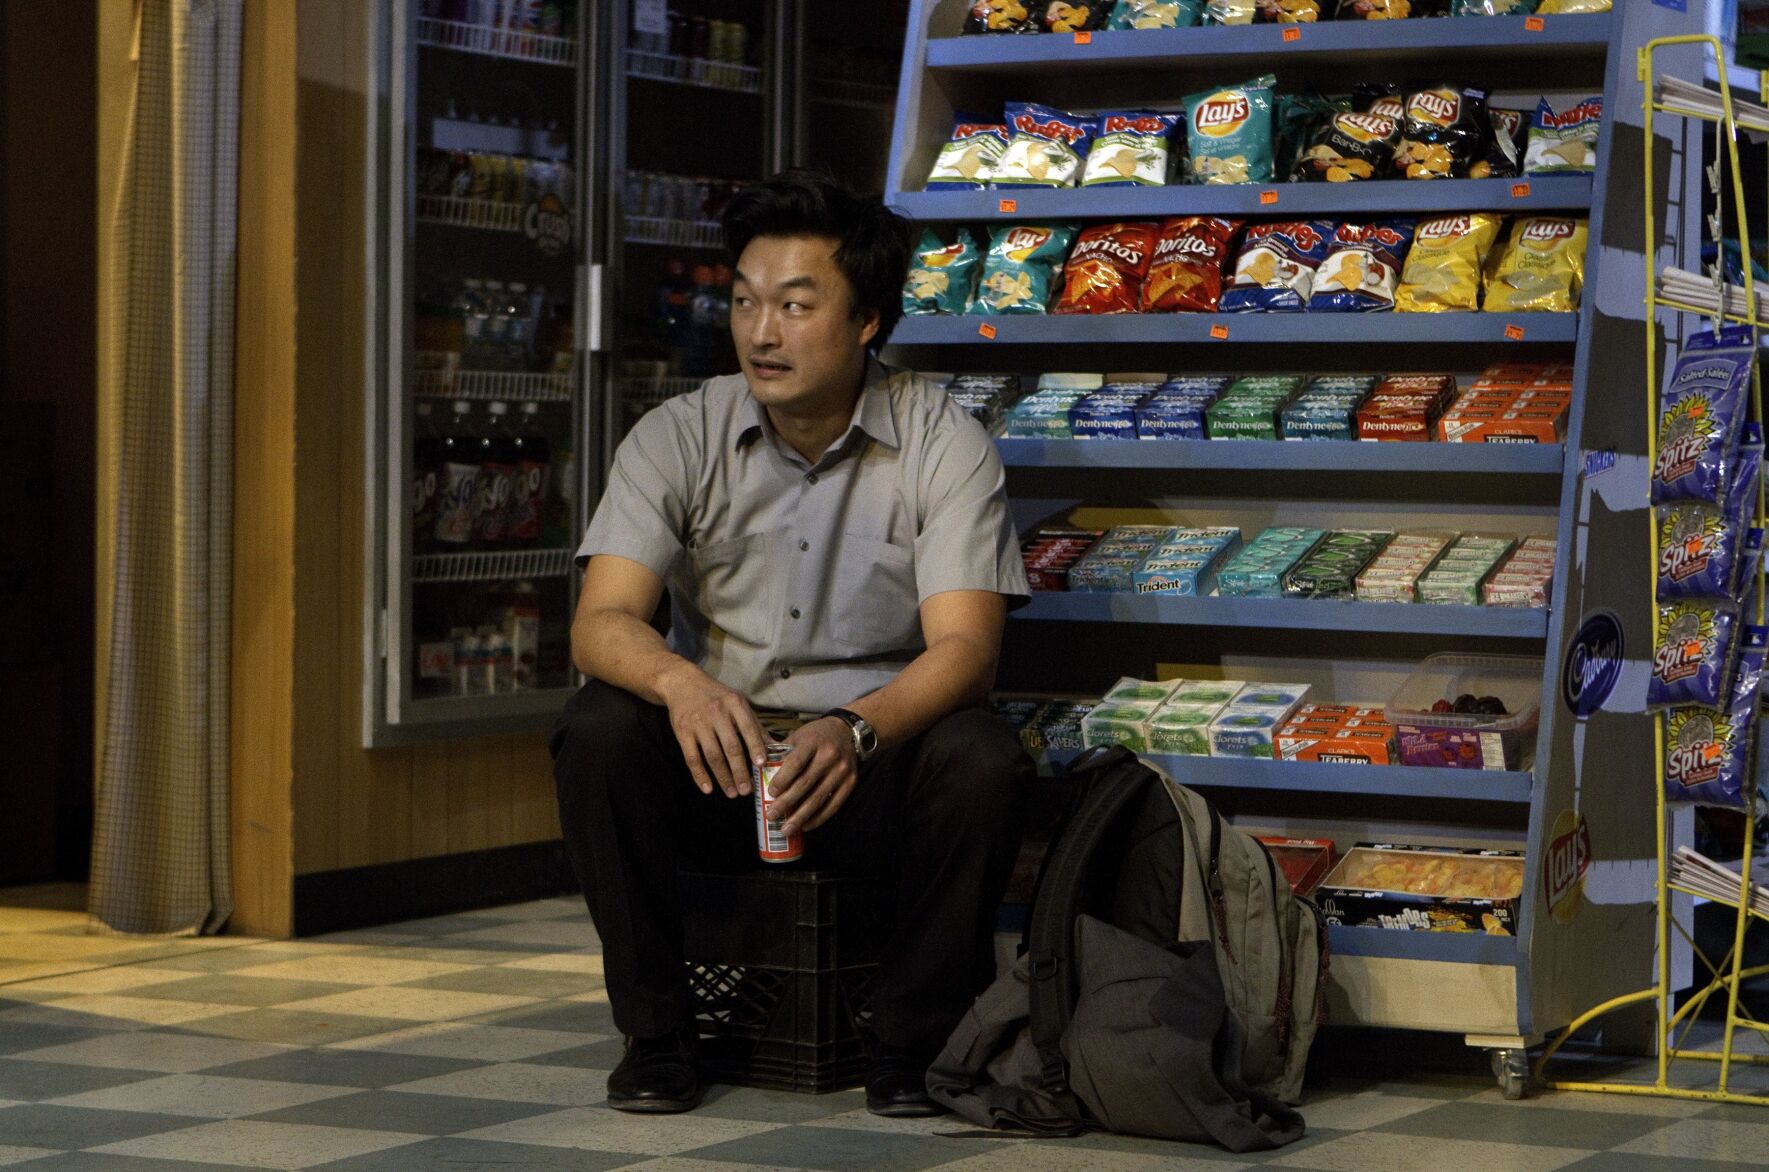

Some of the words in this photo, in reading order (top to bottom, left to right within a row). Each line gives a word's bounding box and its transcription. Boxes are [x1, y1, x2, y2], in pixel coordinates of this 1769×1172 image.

[1075, 419, 1113, 431] Dentyne
[1141, 419, 1179, 431] Dentyne
[1213, 421, 1251, 432] Dentyne
[1286, 421, 1325, 432] Dentyne
[1362, 421, 1402, 433] Dentyne
[1654, 437, 1706, 480] Spitz
[1136, 580, 1180, 595] Trident
